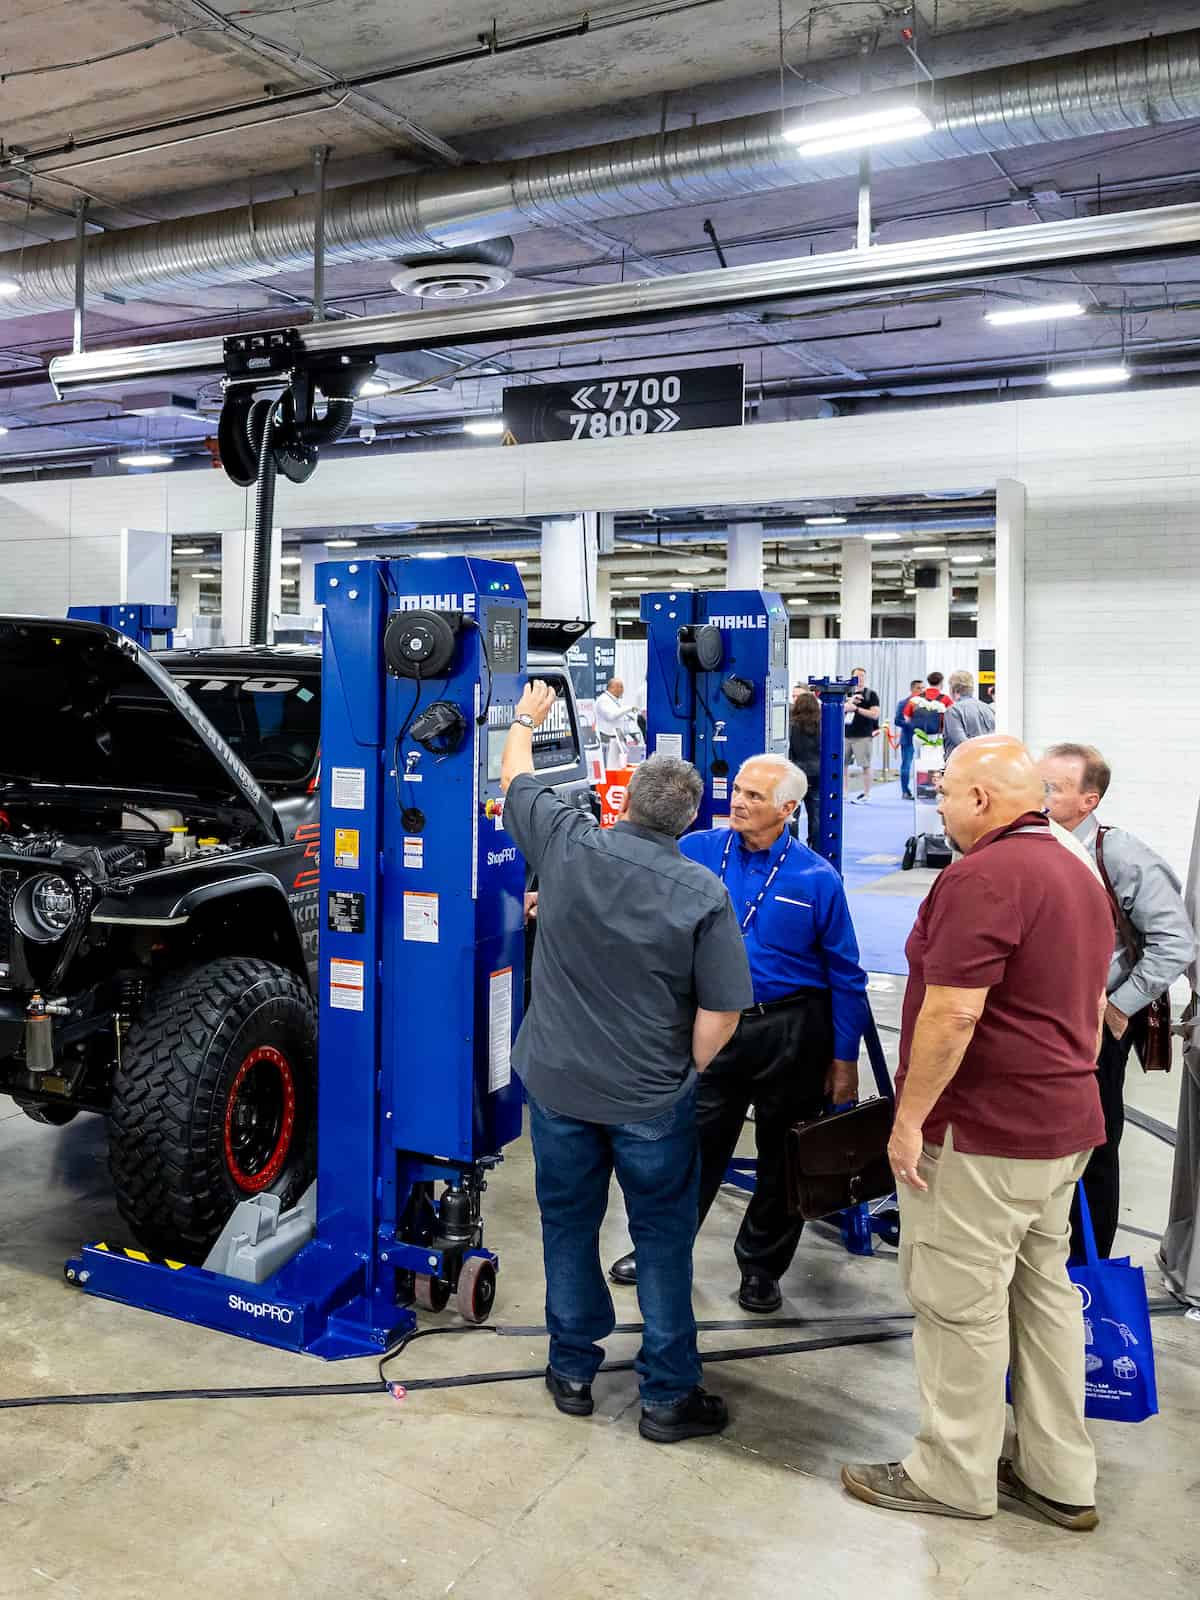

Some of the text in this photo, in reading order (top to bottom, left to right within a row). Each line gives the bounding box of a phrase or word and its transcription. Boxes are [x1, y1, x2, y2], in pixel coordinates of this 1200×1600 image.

[602, 376, 681, 409] 7700
[570, 409, 648, 440] 7800
[400, 593, 476, 612] MAHLE
[709, 615, 767, 629] MAHLE
[488, 705, 516, 726] MAHL
[487, 847, 516, 866] ShopPRO
[228, 1294, 295, 1323] ShopPRO
